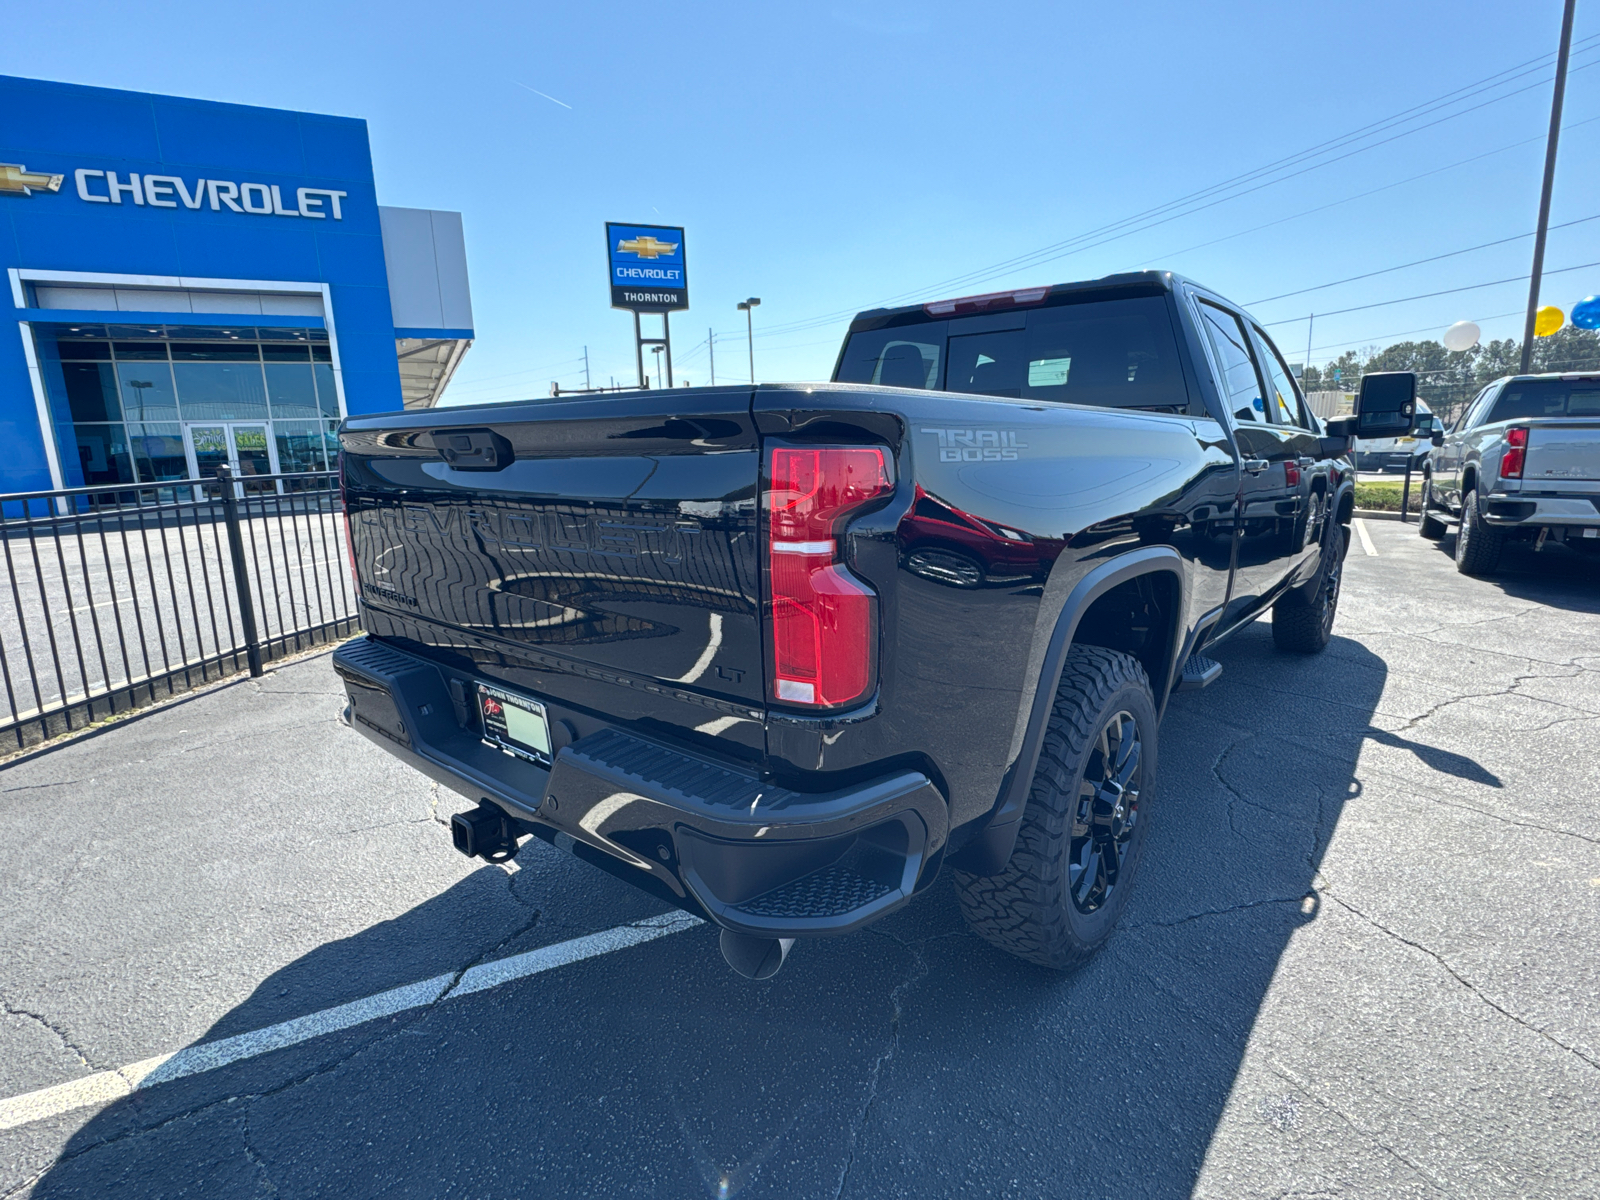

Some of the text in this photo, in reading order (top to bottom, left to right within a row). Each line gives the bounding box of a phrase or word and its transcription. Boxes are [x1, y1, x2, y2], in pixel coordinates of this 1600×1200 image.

[75, 168, 348, 220] CHEVROLET
[616, 267, 680, 280] CHEVROLET
[624, 292, 678, 303] THORNTON
[920, 427, 1029, 449] TRAIL
[939, 447, 1019, 463] BOSS
[358, 497, 701, 565] CHEVROLET
[363, 583, 418, 607] SILVERADO
[714, 664, 747, 684] LT
[489, 688, 542, 714] JOHN THORNTON
